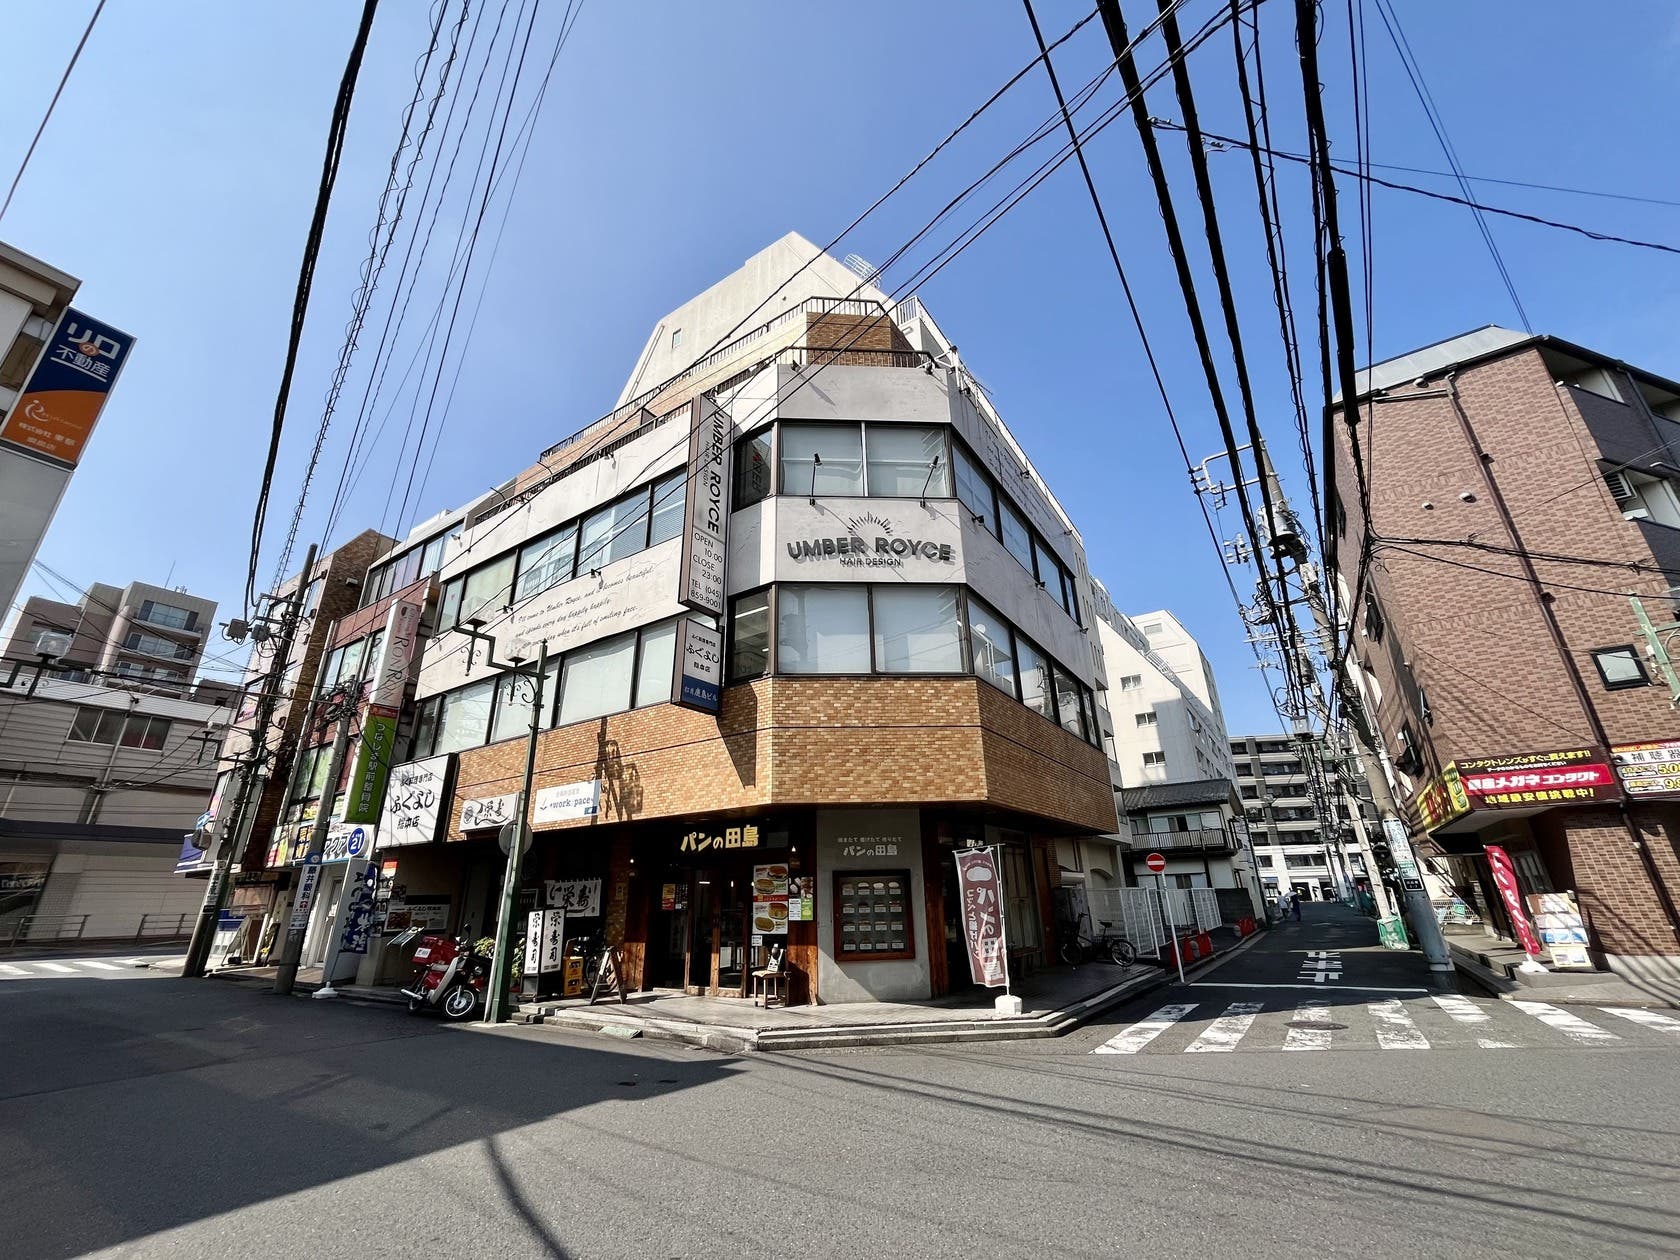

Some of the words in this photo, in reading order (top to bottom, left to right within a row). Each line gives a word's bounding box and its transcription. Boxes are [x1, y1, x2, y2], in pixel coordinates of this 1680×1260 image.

[56, 344, 111, 378] 不動産
[712, 412, 725, 466] UMBER
[707, 471, 722, 534] ROYCE
[694, 532, 714, 548] OPEN
[787, 537, 866, 560] UMBER
[875, 536, 952, 562] ROYCE
[693, 554, 715, 571] CLOSE
[839, 557, 862, 566] HAIR
[865, 557, 902, 567] DESIGN
[702, 570, 722, 584] 23:00
[691, 579, 701, 589] TEL
[705, 585, 722, 599] (045)
[690, 590, 721, 609] 859-9001
[686, 643, 720, 664] ふぐよし
[358, 722, 386, 814] つなしま駅前整骨院
[1542, 771, 1600, 785] コンタクト
[390, 789, 435, 814] ふぐよし
[350, 833, 363, 850] 21
[681, 824, 760, 852] パンの田島
[843, 844, 898, 857] パンの田島
[549, 911, 562, 962] 栄寿司
